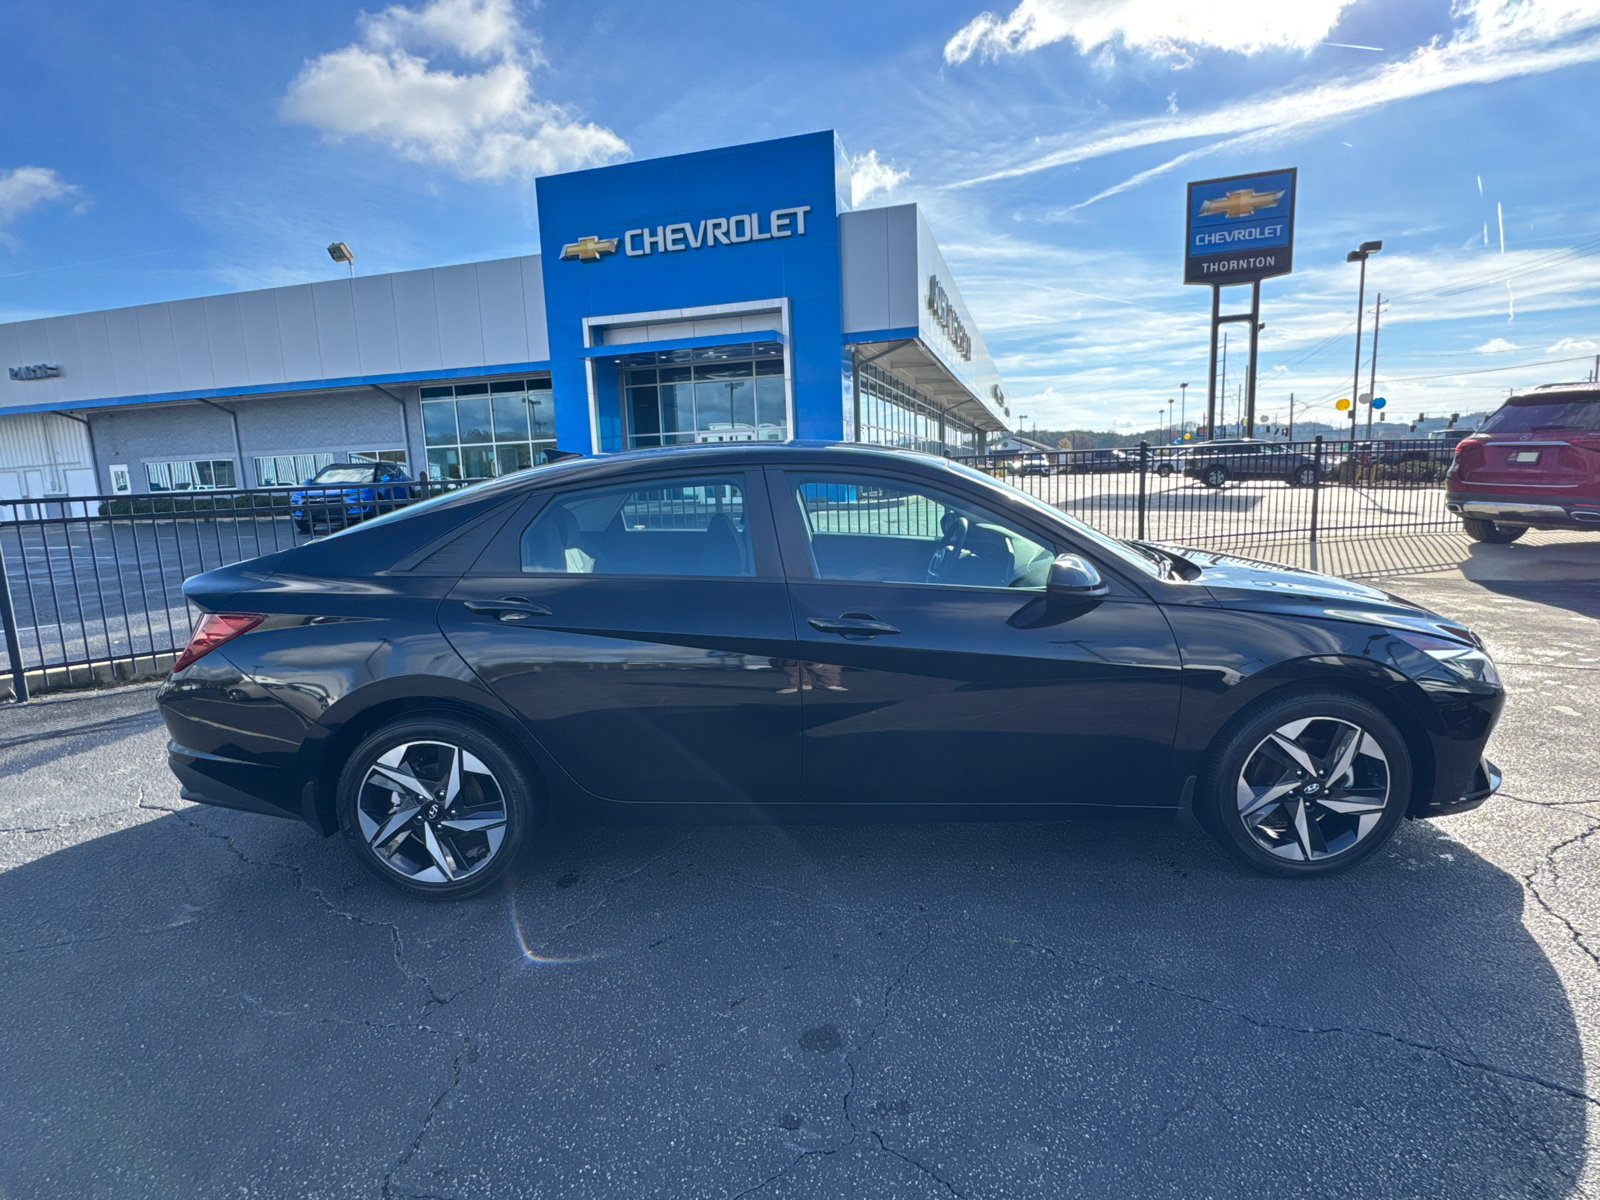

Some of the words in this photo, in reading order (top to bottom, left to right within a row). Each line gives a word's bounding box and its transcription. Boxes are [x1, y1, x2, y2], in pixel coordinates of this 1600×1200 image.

[624, 205, 811, 256] CHEVROLET
[1195, 225, 1283, 245] CHEVROLET
[1202, 256, 1275, 273] THORNTON
